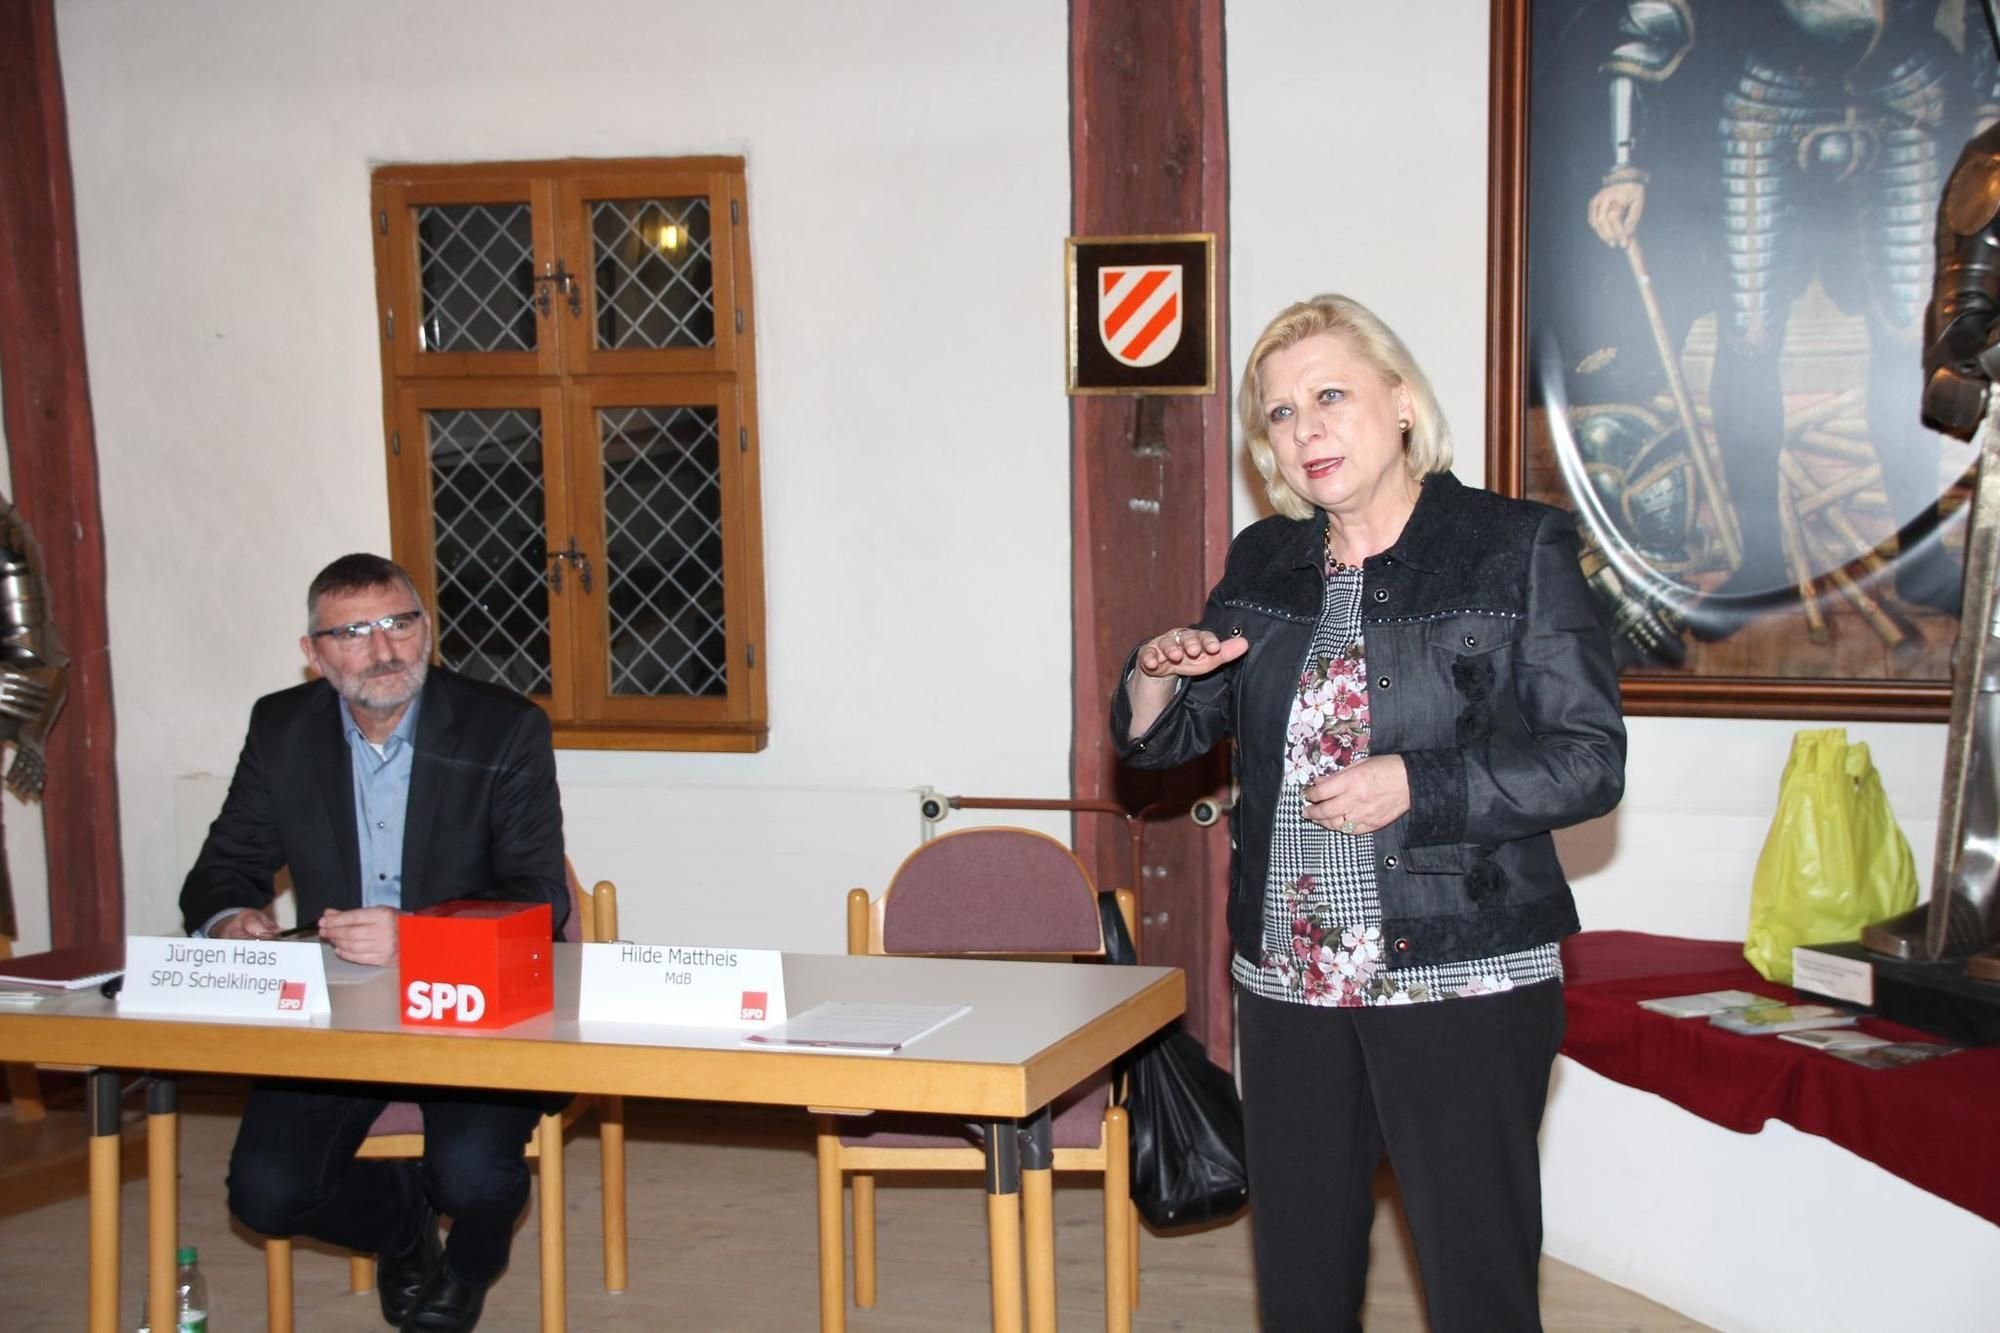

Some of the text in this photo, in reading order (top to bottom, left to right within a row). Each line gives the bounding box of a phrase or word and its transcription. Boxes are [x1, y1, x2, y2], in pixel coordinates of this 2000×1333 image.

[165, 944, 277, 967] Jürgen Haas
[621, 946, 738, 968] Hilde Mattheis
[151, 970, 287, 994] SPD Schelklingen
[665, 970, 692, 985] MdB
[279, 999, 300, 1010] SPD
[407, 981, 485, 1023] SPD
[741, 1008, 764, 1019] SPD
